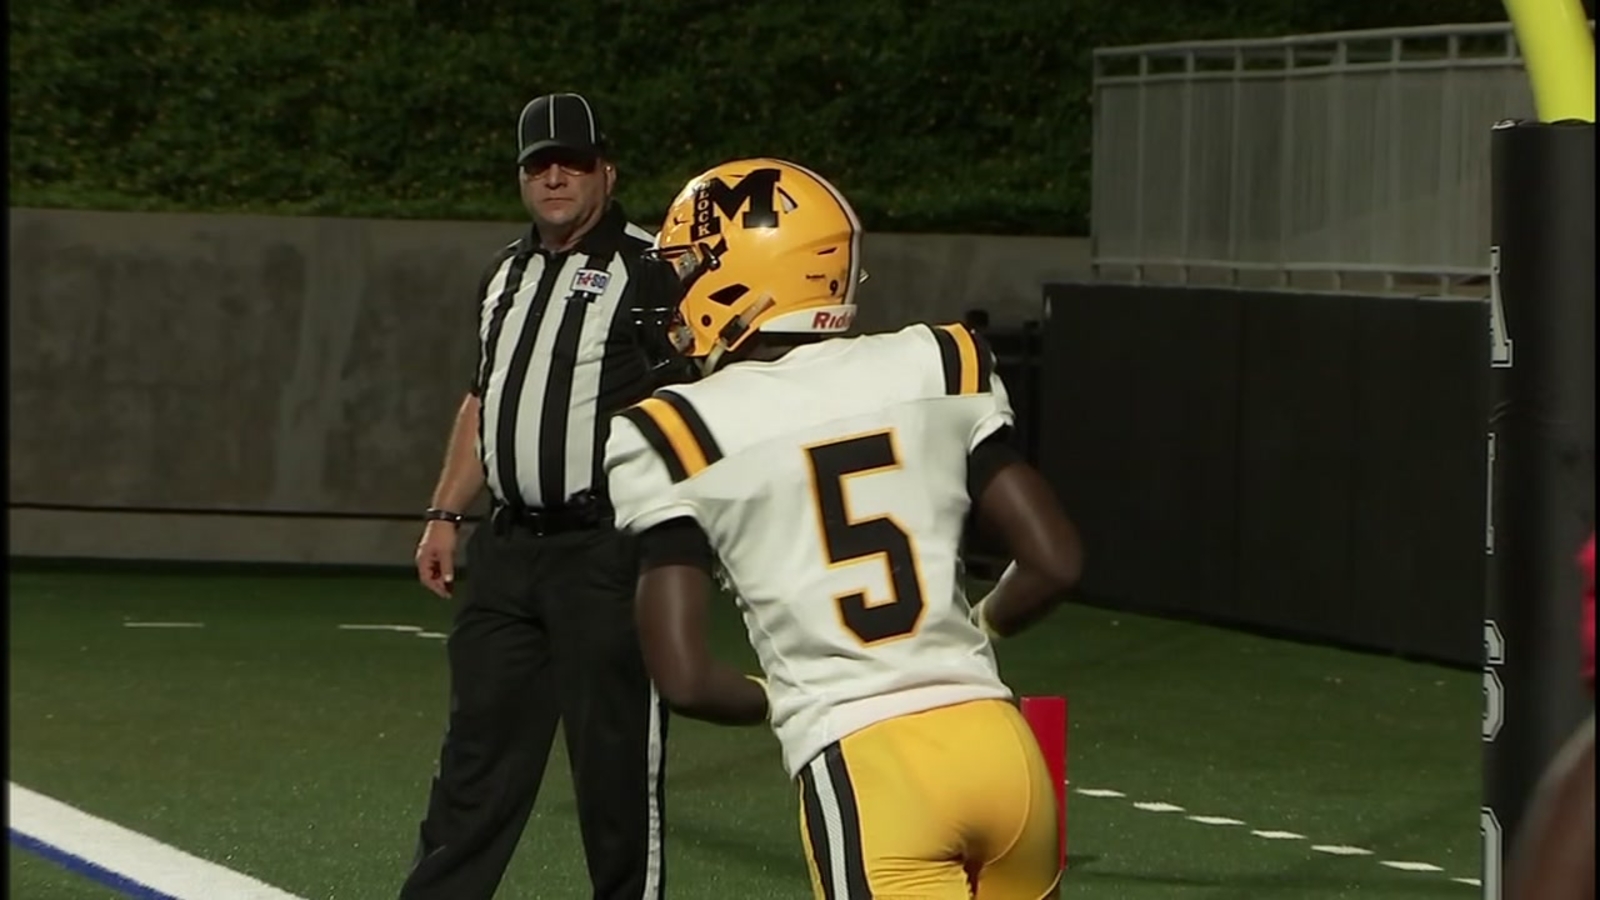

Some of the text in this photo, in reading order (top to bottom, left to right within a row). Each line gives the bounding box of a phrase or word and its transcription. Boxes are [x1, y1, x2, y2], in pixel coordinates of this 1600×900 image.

[691, 168, 781, 241] M
[829, 279, 839, 296] 9
[801, 427, 928, 648] 5
